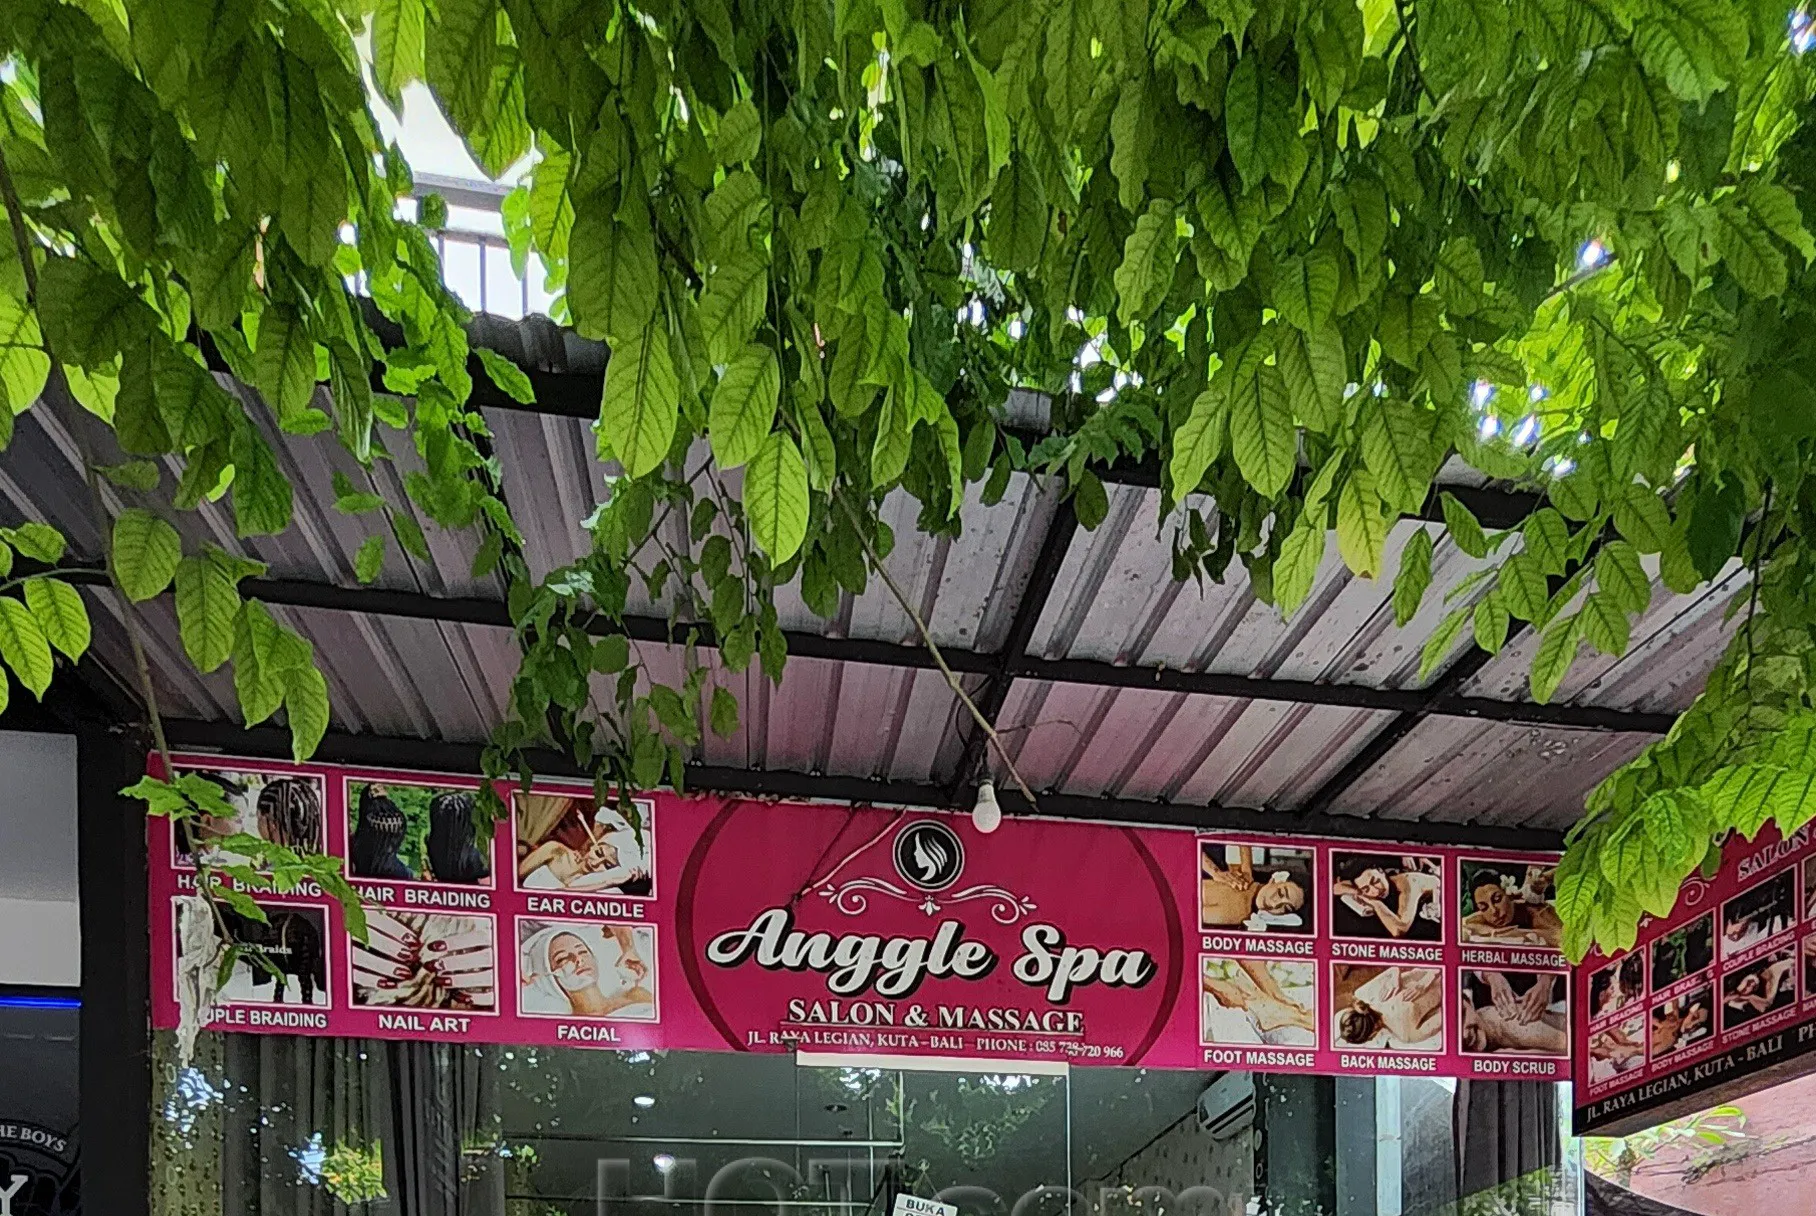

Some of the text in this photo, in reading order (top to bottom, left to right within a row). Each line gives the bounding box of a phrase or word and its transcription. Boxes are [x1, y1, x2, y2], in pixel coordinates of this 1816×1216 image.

[404, 888, 491, 908] BRAIDING
[526, 897, 645, 918] EAR CANDLE
[706, 907, 1159, 1003] Anggle Spa
[1202, 936, 1314, 955] BODY MASSAGE
[1331, 942, 1444, 961] STONE MASSAGE
[1461, 949, 1567, 967] HERBAL MASSAGE
[207, 1008, 328, 1029] UPLE BRAIDING
[378, 1014, 471, 1033] NAIL ART
[789, 998, 1084, 1033] SALON & MASSAGE
[557, 1025, 622, 1042] FACIAL
[814, 1031, 875, 1048] LEGIAN,
[976, 1036, 1027, 1052] PHONE
[1103, 1045, 1124, 1058] 966
[1203, 1049, 1315, 1067] FOOT MASSAGE
[1340, 1054, 1437, 1071] BACK MASSAGE
[1473, 1058, 1556, 1075] BODY SCRUB
[1603, 1092, 1636, 1115] RAYA
[1638, 1070, 1693, 1099] LEGIAN,
[1694, 1054, 1735, 1082] KUTA
[1746, 1034, 1784, 1062] BALI
[20, 1127, 68, 1152] BOYS
[905, 1198, 946, 1216] BUKA
